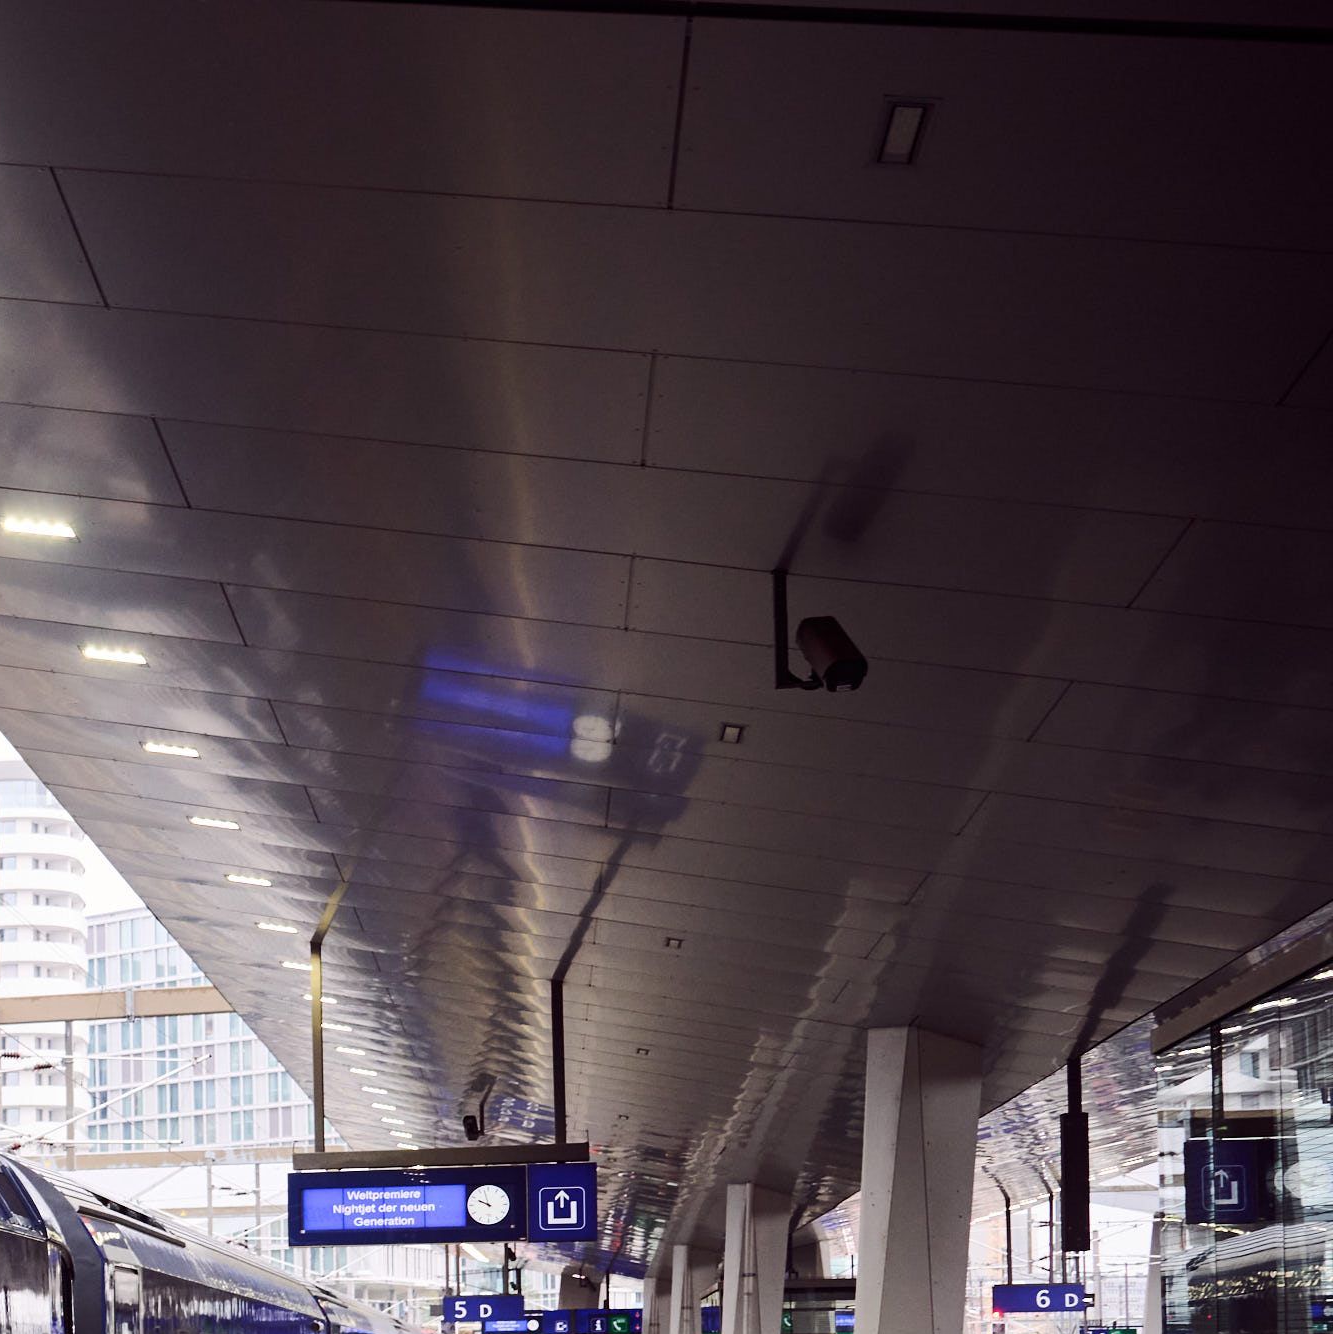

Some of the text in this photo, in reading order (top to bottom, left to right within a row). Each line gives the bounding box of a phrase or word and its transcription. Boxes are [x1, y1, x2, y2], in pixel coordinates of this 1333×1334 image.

[346, 1189, 421, 1201] Weltpremiere
[332, 1202, 436, 1216] Nightjet der neuen
[353, 1216, 415, 1227] Generation
[1036, 1289, 1079, 1309] 6 D
[454, 1301, 493, 1319] 5 D
